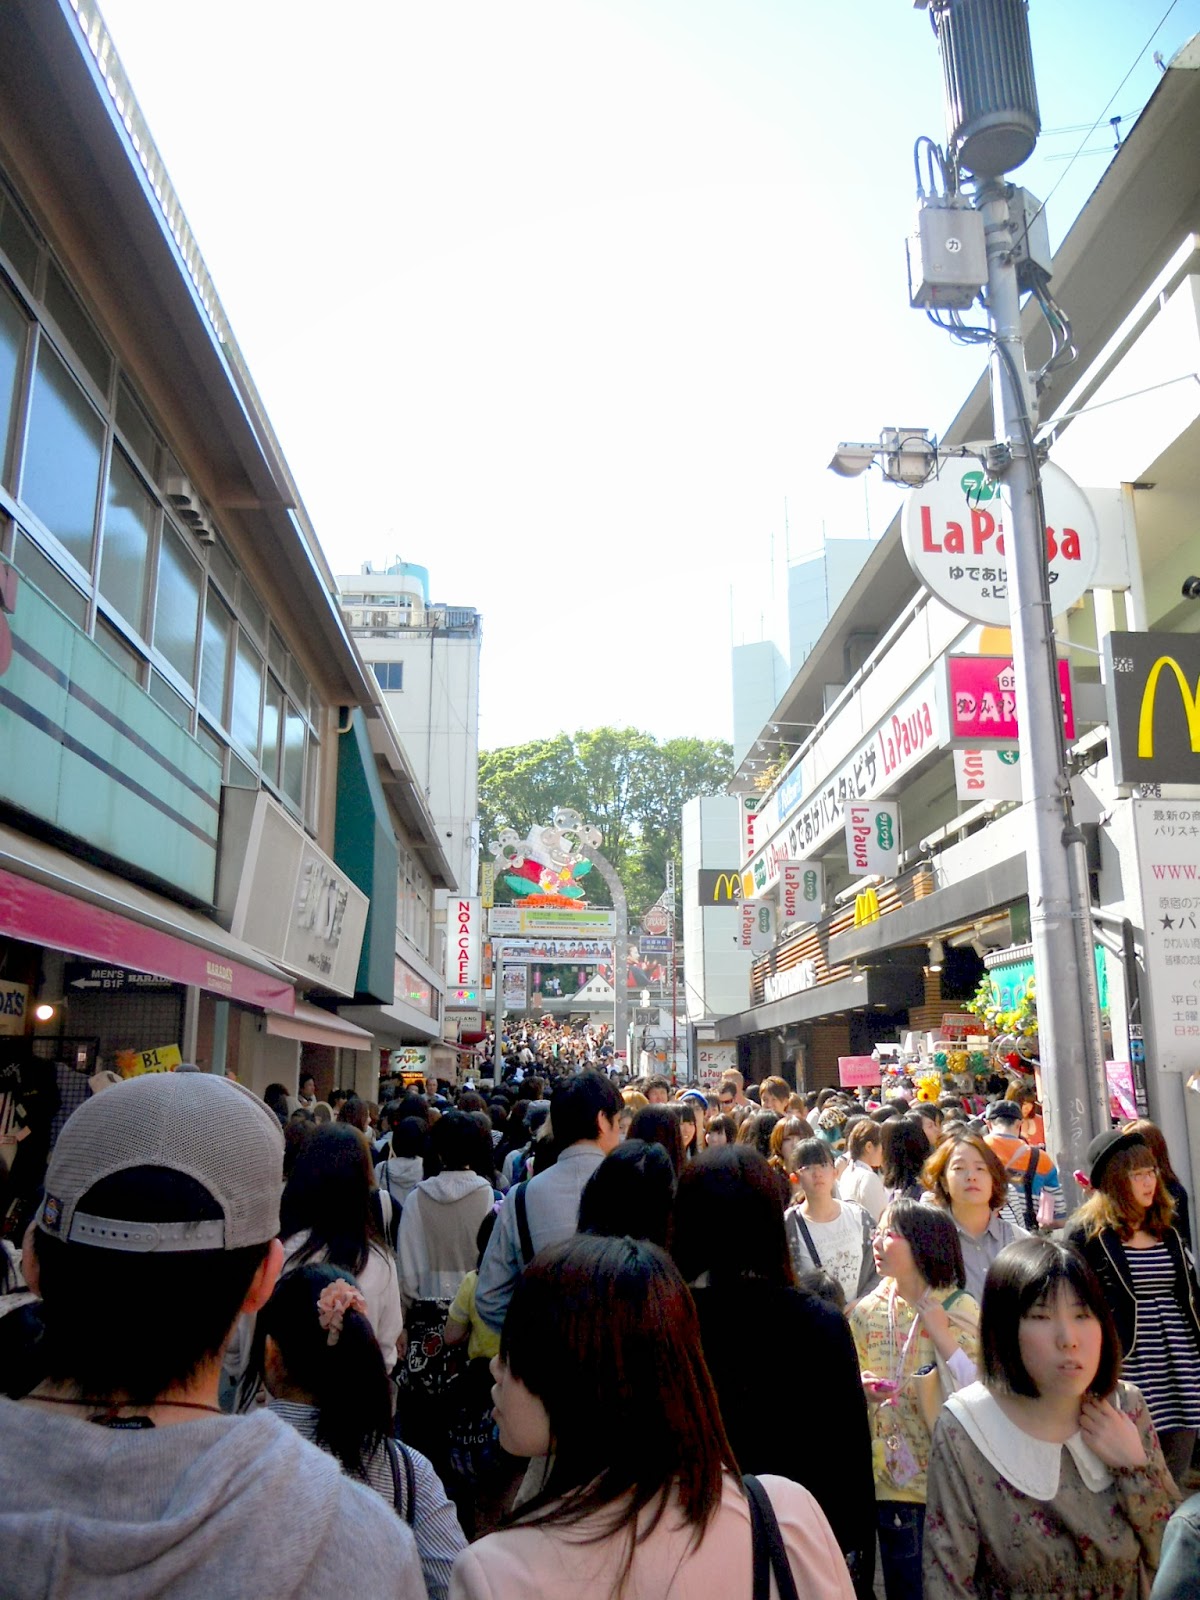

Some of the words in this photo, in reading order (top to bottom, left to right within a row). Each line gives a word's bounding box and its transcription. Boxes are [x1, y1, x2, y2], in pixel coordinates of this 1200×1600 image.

[91, 969, 125, 979] MEN'S
[103, 979, 125, 989] B1F
[142, 1049, 161, 1068] B1
